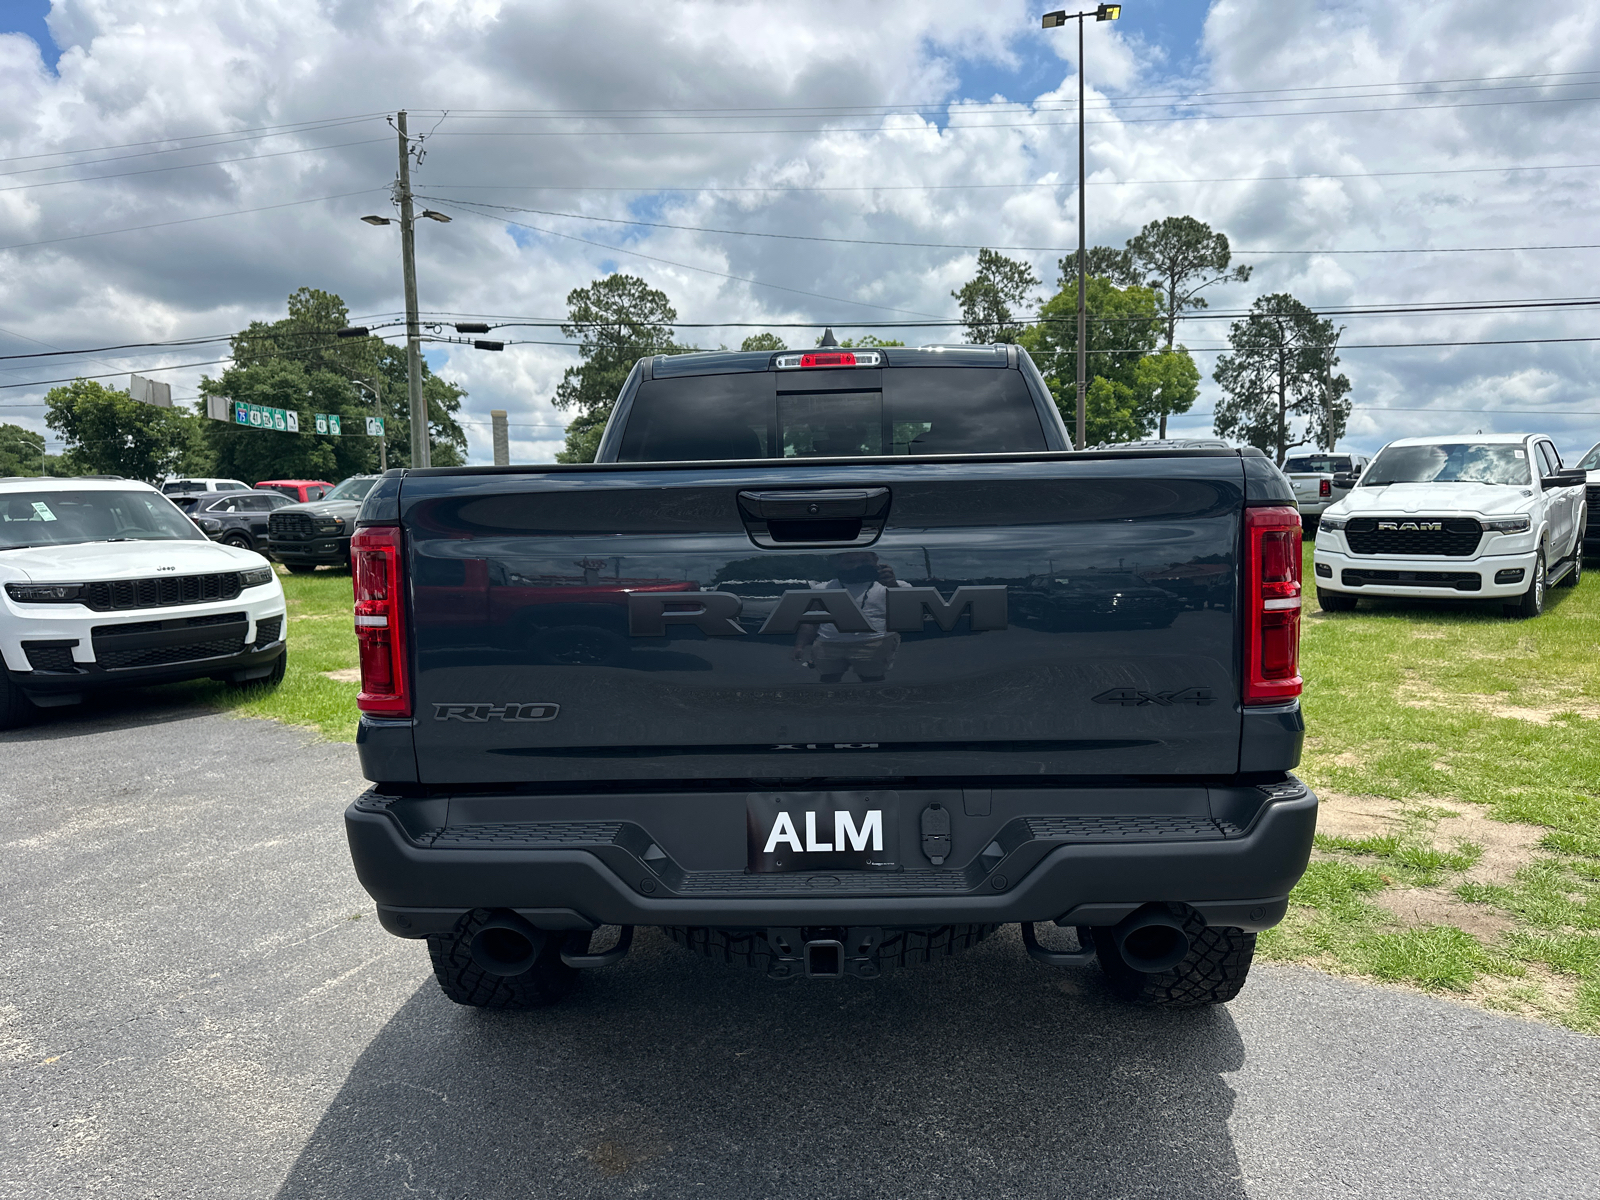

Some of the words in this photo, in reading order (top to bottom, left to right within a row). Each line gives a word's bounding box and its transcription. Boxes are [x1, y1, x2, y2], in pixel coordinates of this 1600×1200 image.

[239, 411, 246, 422] 75
[1378, 521, 1442, 531] RAM
[628, 584, 1009, 637] RAM
[431, 702, 561, 723] RHO
[763, 810, 883, 853] ALM
